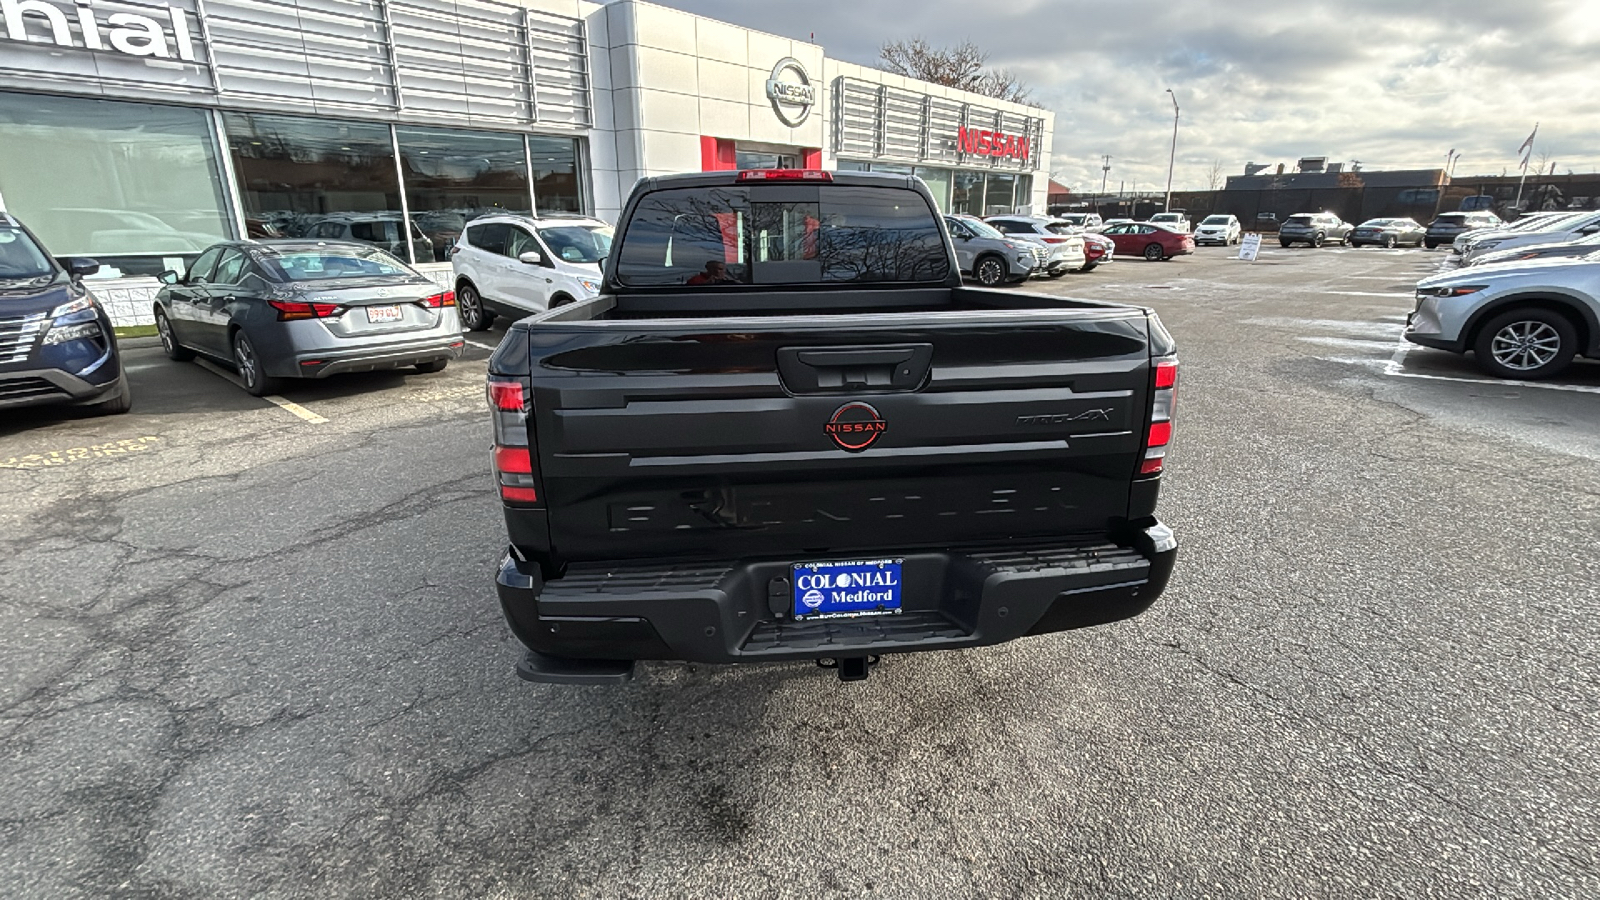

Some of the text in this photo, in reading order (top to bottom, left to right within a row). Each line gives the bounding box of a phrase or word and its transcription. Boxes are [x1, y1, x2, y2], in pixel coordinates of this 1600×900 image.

[773, 83, 813, 101] NISSAN
[957, 126, 1030, 160] NISSAN
[825, 422, 886, 433] NISSAN
[797, 571, 898, 590] COLONIAL
[831, 589, 893, 604] Medford
